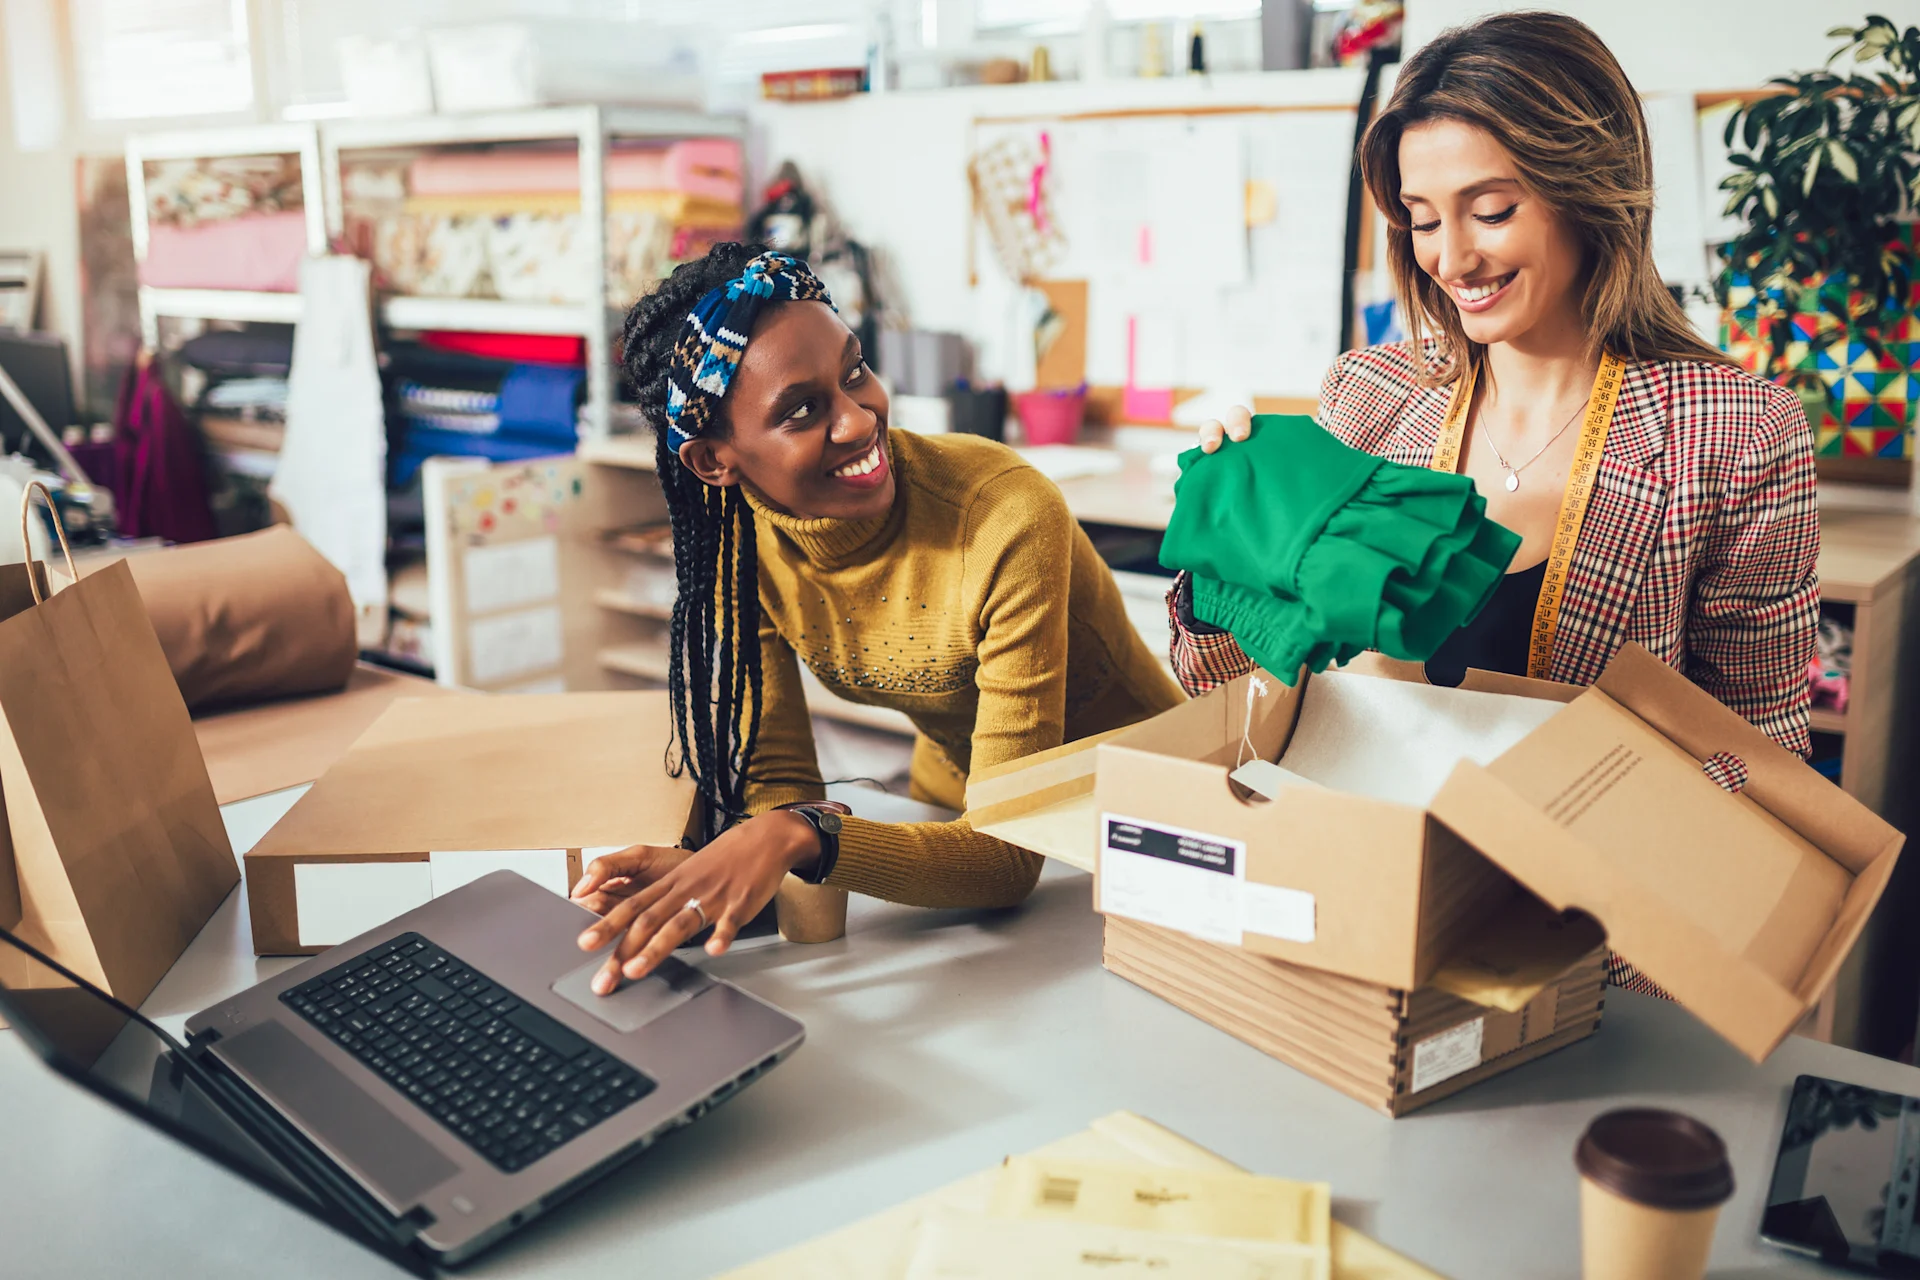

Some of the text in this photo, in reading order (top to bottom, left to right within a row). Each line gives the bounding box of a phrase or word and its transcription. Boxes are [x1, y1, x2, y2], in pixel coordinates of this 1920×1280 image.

[1608, 369, 1616, 378] 61
[1604, 381, 1613, 389] 60
[1601, 392, 1610, 400] 59
[1598, 404, 1607, 412] 58
[1594, 415, 1603, 424] 57
[1591, 426, 1600, 435] 56
[1444, 437, 1452, 445] 93
[1588, 438, 1597, 447] 55
[1442, 448, 1450, 456] 94
[1585, 451, 1594, 459] 54
[1440, 460, 1448, 468] 95
[1582, 463, 1590, 472] 53
[1578, 475, 1587, 484] 52
[1575, 487, 1584, 496] 51
[1571, 500, 1580, 509] 50
[1568, 512, 1576, 520] 49
[1565, 524, 1573, 532] 48
[1559, 548, 1566, 556] 46
[1556, 560, 1563, 568] 45
[1549, 585, 1556, 593] 43
[1546, 597, 1554, 605] 42
[1543, 609, 1551, 618] 41
[1541, 621, 1549, 630] 40
[1539, 633, 1548, 642] 39
[1538, 645, 1547, 654] 38
[1537, 657, 1546, 666] 37
[1536, 669, 1544, 678] 36
